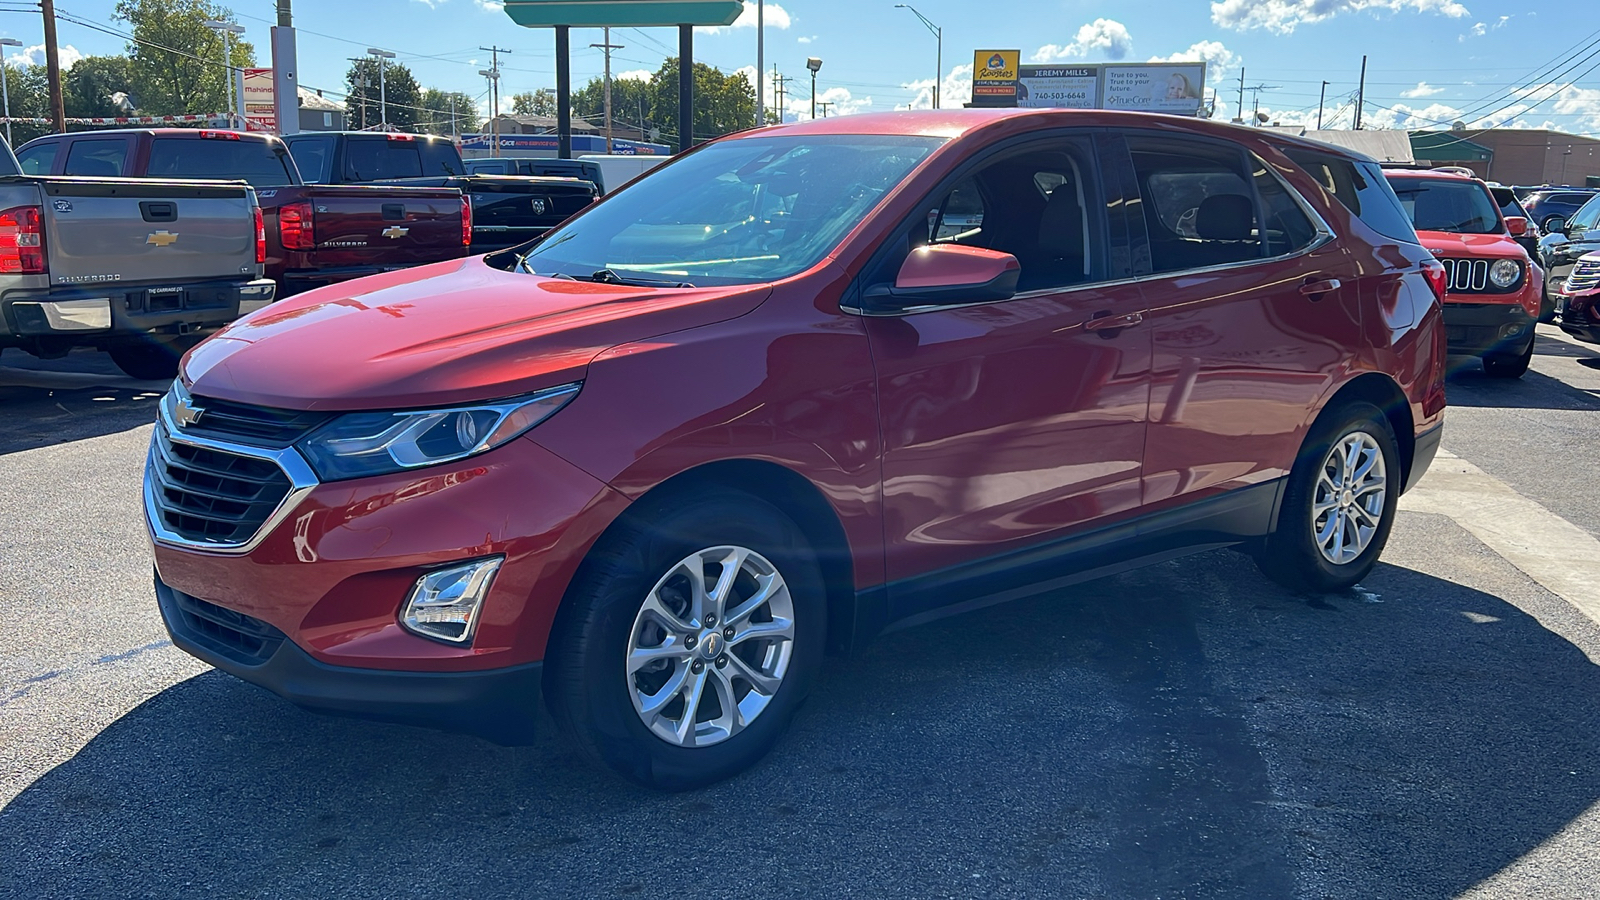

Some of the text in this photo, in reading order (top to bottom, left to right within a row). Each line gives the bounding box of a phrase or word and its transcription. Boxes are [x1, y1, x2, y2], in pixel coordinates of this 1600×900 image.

[979, 68, 1013, 79] Roosters
[1115, 96, 1151, 104] TrueCore
[58, 274, 120, 282] SILVERADO
